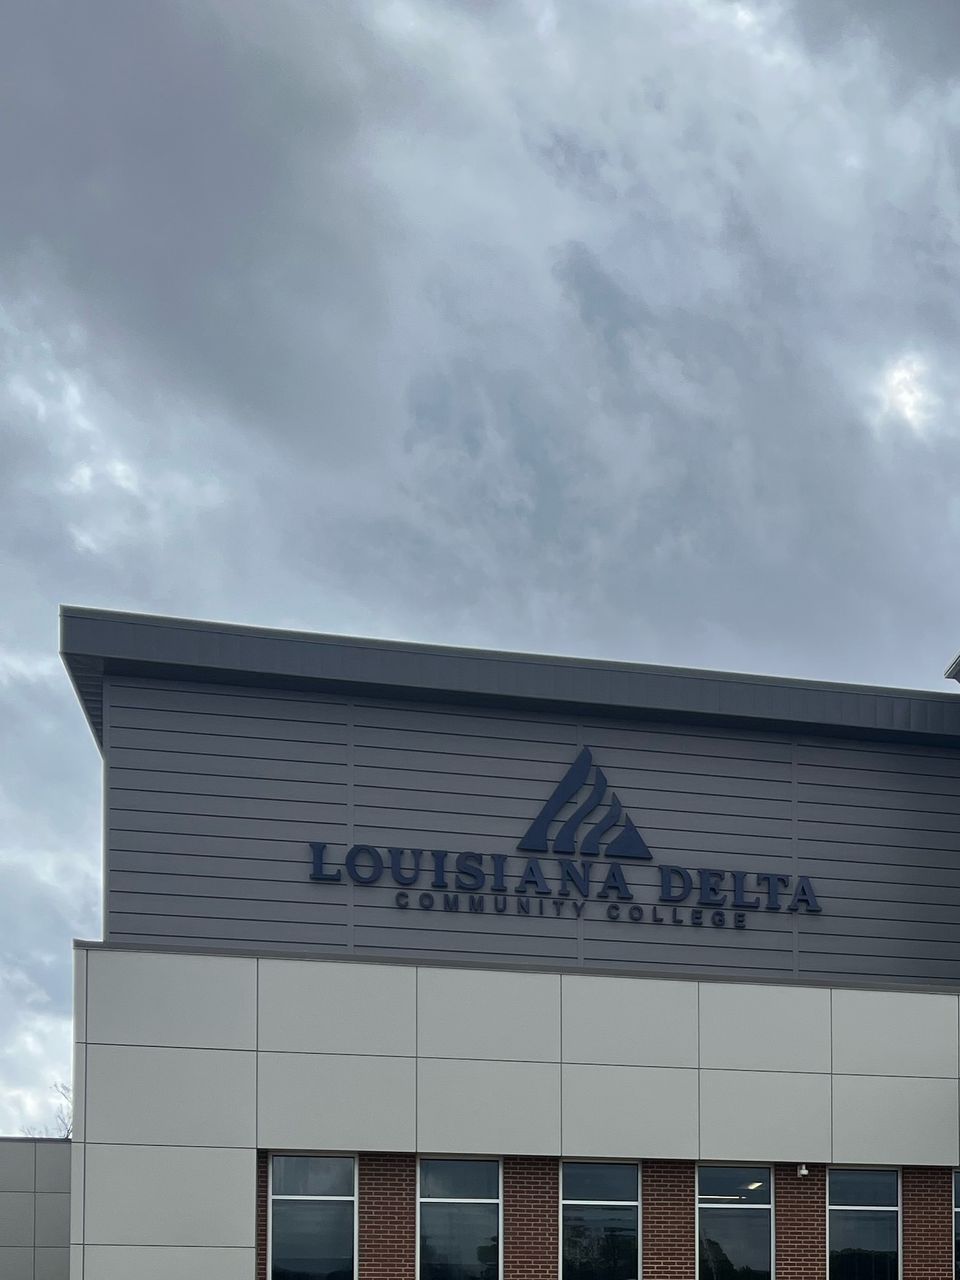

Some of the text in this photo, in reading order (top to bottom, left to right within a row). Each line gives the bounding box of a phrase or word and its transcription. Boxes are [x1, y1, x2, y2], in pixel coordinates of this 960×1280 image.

[309, 842, 822, 912] LOUISIANA DELTA
[395, 891, 747, 928] COMMUNITY COLLEGE
